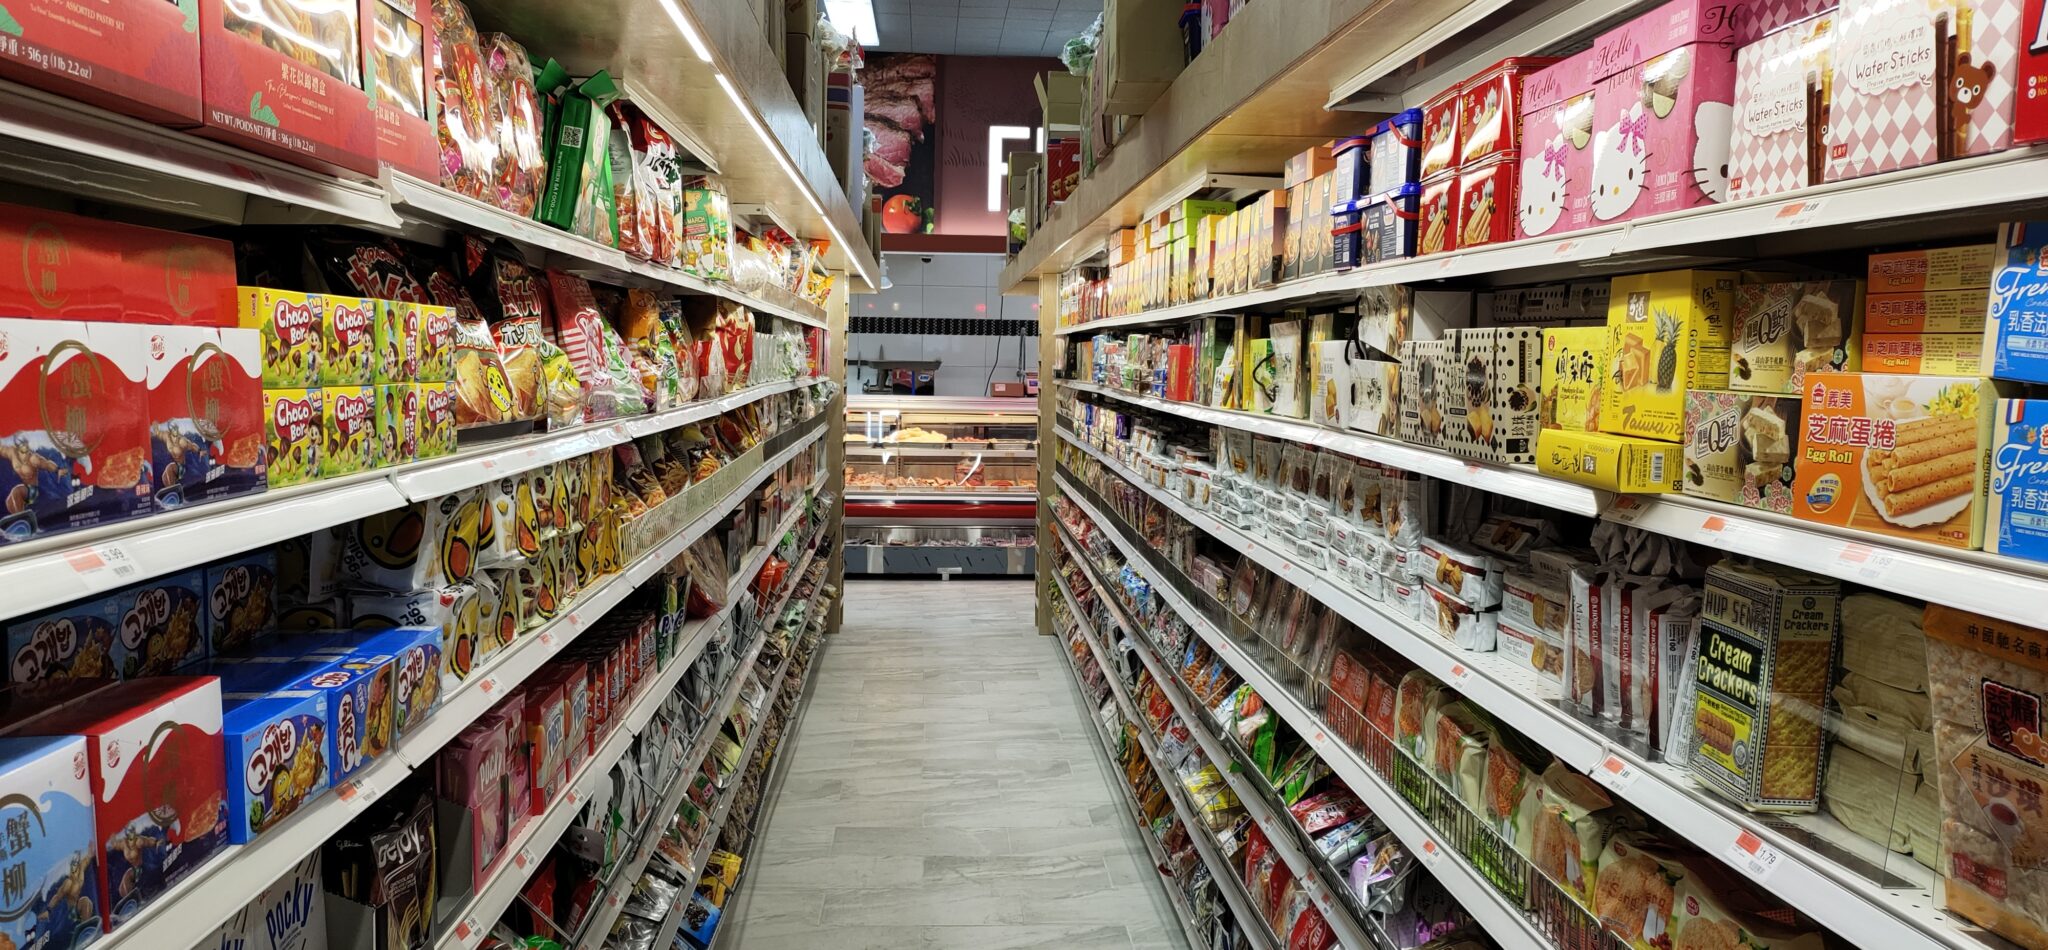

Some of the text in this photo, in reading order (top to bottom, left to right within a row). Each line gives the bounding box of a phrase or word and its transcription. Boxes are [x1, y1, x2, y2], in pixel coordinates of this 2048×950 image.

[27, 46, 41, 62] 516
[42, 54, 48, 69] g
[67, 60, 79, 76] 2.2
[1594, 28, 1632, 75] Hello
[1856, 46, 1931, 80] Wafer Sticks
[1748, 98, 1804, 124] Wafer Sticks
[988, 126, 1043, 212] F
[276, 304, 309, 328] Choco
[335, 308, 363, 331] Choco
[1876, 341, 1924, 357] 芝麻蛋捲
[1882, 358, 1909, 367] Egg Roll
[337, 398, 363, 420] Choco
[1827, 390, 1853, 409] 義美
[276, 402, 309, 426] Choco
[1806, 414, 1896, 450] 芝麻蛋捲
[1805, 447, 1853, 464] Egg Roll
[212, 567, 249, 615] 고래밥
[1705, 590, 1728, 618] HUP
[124, 588, 169, 646] 고래밥
[1591, 604, 1599, 629] KHONG
[1784, 620, 1829, 632] Crackers
[1791, 609, 1824, 621] Cream
[1710, 633, 1752, 674] Cream
[1698, 655, 1758, 706] Crackers
[250, 723, 293, 788] 고래밥
[3, 811, 32, 908] 蟹柳
[1759, 849, 1778, 866] 1.79
